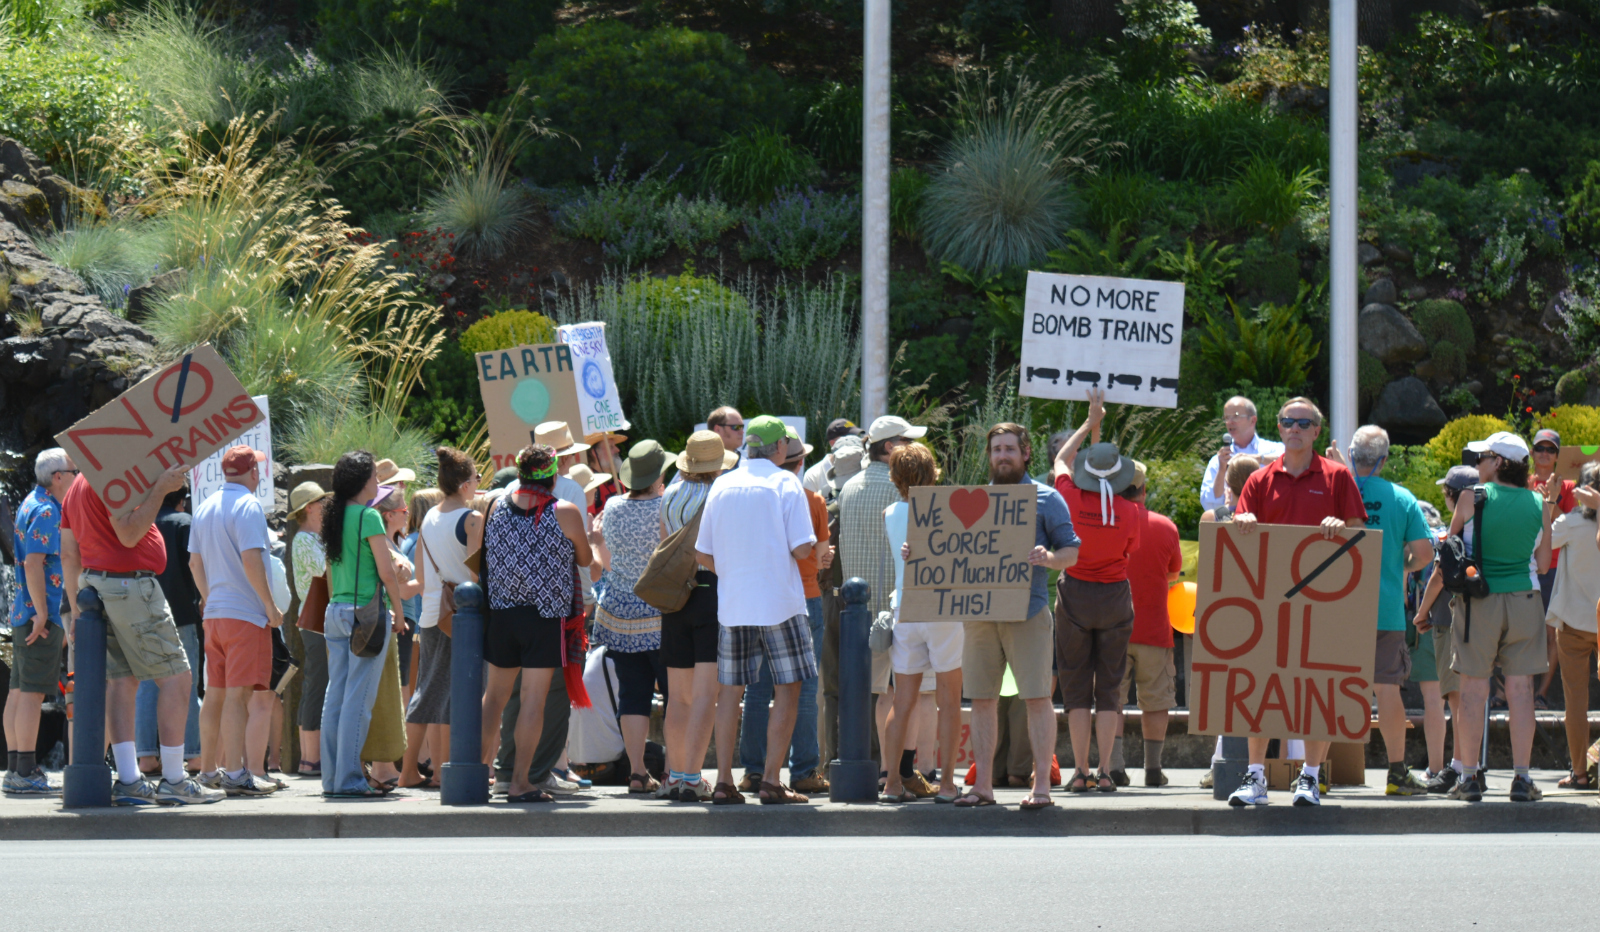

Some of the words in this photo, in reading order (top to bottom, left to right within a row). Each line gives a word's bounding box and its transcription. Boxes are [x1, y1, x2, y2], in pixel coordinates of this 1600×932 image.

[1051, 283, 1091, 306] NO
[1097, 287, 1160, 312] MORE
[1032, 312, 1092, 338] BOMB
[1098, 318, 1174, 345] TRAINS
[572, 341, 591, 358] ONE
[587, 412, 621, 431] FUTURE
[594, 399, 611, 414] ONE
[146, 394, 258, 471] TRAINS
[102, 465, 158, 510] OIL
[911, 492, 944, 528] WE
[989, 493, 1029, 526] THE
[927, 529, 1001, 556] GORGE
[907, 557, 946, 586] TOO
[950, 556, 996, 584] MUCH
[997, 554, 1030, 583] FOR
[1212, 526, 1366, 602] NO
[933, 588, 992, 616] THIS!
[1199, 597, 1362, 673] OIL
[1191, 662, 1372, 740] TRAINS
